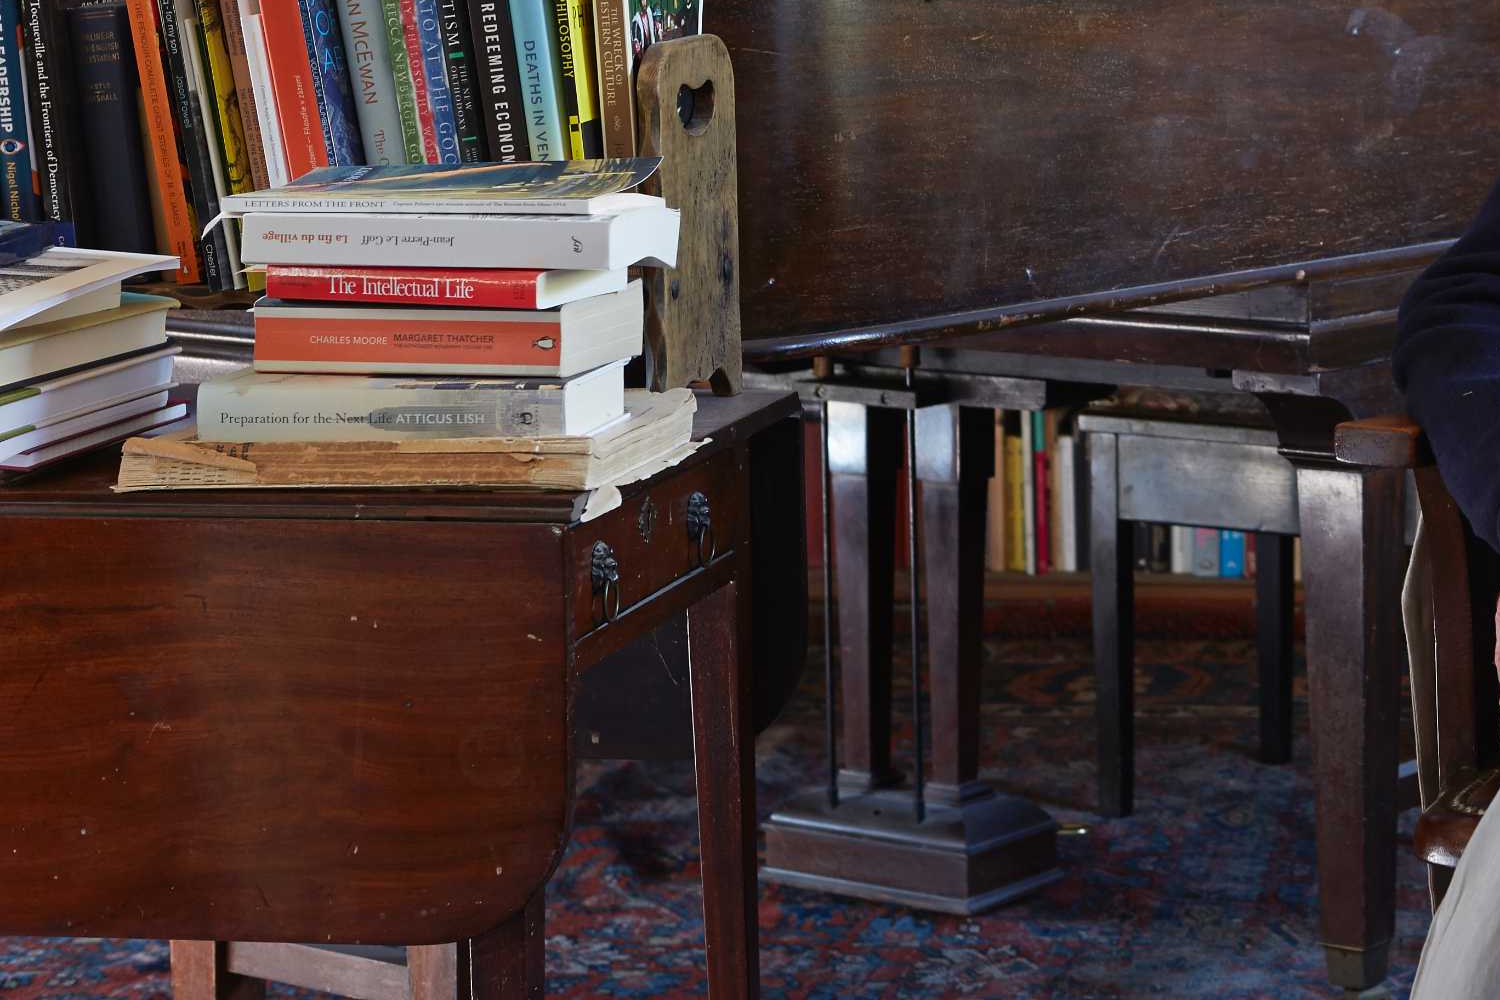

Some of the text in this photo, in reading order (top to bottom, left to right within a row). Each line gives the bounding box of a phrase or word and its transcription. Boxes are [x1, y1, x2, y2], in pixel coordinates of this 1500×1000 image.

[166, 10, 174, 23] for
[168, 24, 177, 41] my
[170, 42, 178, 54] son
[425, 41, 442, 67] AT
[481, 2, 507, 94] REDEEMING
[613, 26, 623, 73] WRECK
[406, 20, 428, 115] PHILOSOPHY
[524, 40, 542, 106] DEATHS
[604, 48, 617, 106] CULTURE
[393, 52, 417, 140] NEWBERGER
[428, 74, 450, 113] THE
[450, 65, 468, 131] ORTHODOXY
[456, 63, 473, 111] THE NEW
[30, 1, 62, 222] Tocqueville and the Frontiers of Democracy
[175, 75, 192, 130] Jason Powell
[532, 110, 545, 126] IN
[373, 128, 385, 155] The
[7, 162, 18, 185] Nigel
[157, 135, 170, 168] STORIES
[170, 201, 180, 226] JAMES
[245, 200, 291, 208] LETTERS
[292, 200, 323, 208] FROM
[262, 231, 348, 244] La fin du village
[360, 234, 455, 247] Jean-Pierre Le Goff
[205, 244, 217, 277] Chester
[329, 275, 474, 299] The Intellectual Life
[310, 335, 388, 345] CHARLES MOORE
[393, 333, 495, 344] MARGARET THATCHER
[220, 412, 485, 427] Preparation for the Next Life ATTICUS LISH
